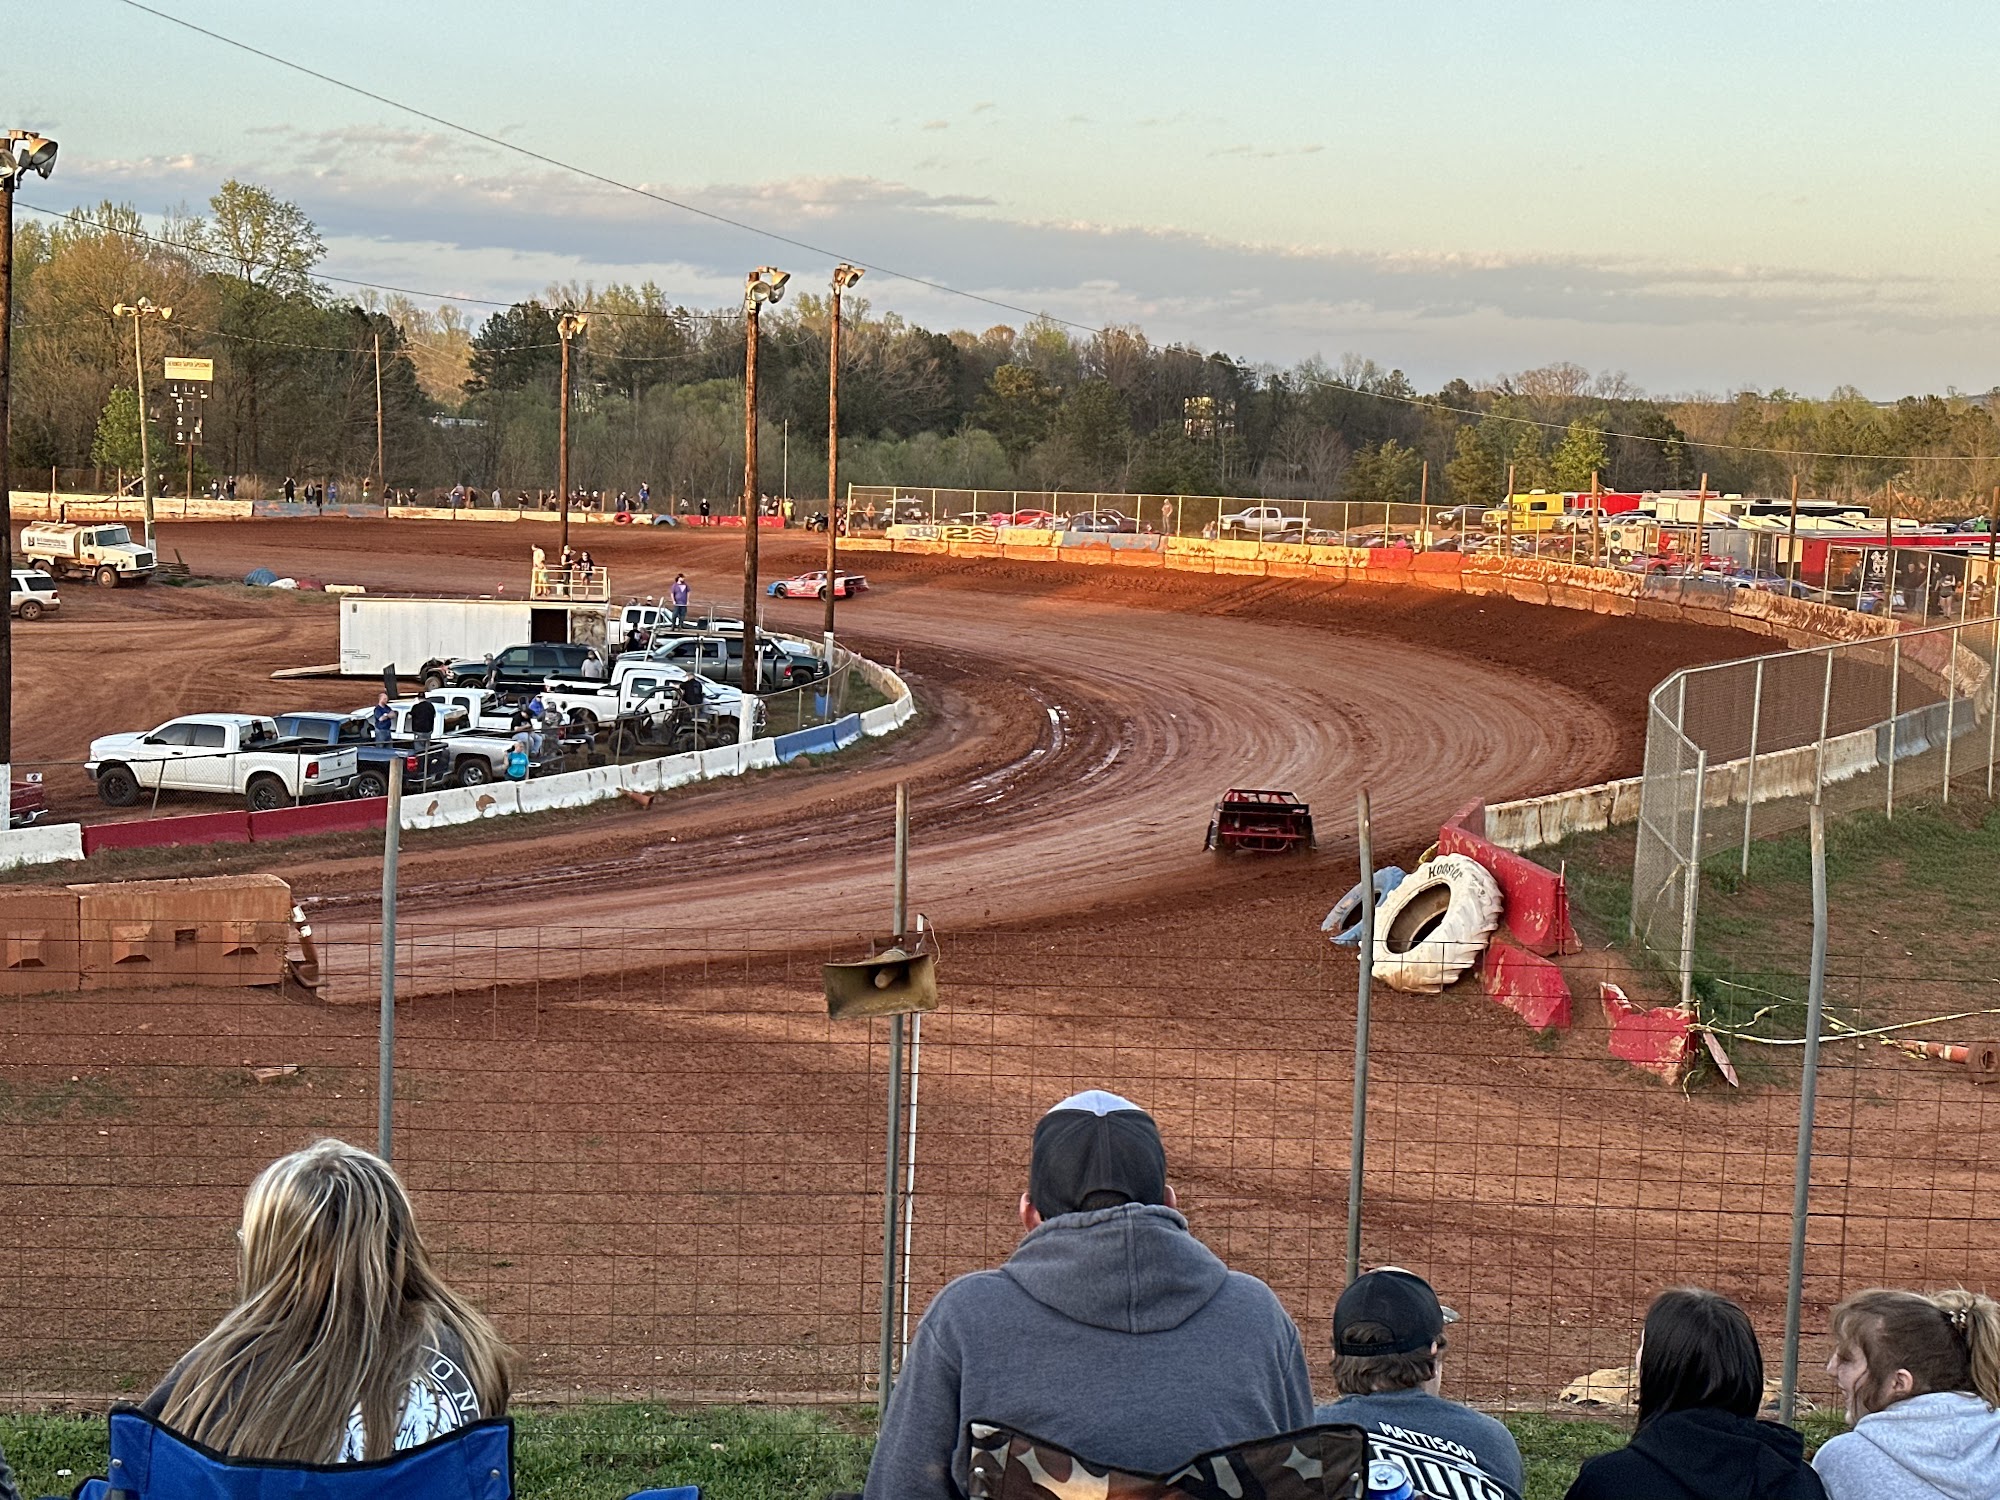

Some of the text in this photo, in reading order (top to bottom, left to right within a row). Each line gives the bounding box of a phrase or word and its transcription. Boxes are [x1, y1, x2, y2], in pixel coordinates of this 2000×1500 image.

[177, 417, 183, 425] 2
[177, 432, 183, 440] 3
[947, 528, 969, 539] 2
[1378, 1421, 1477, 1464] MATTISON
